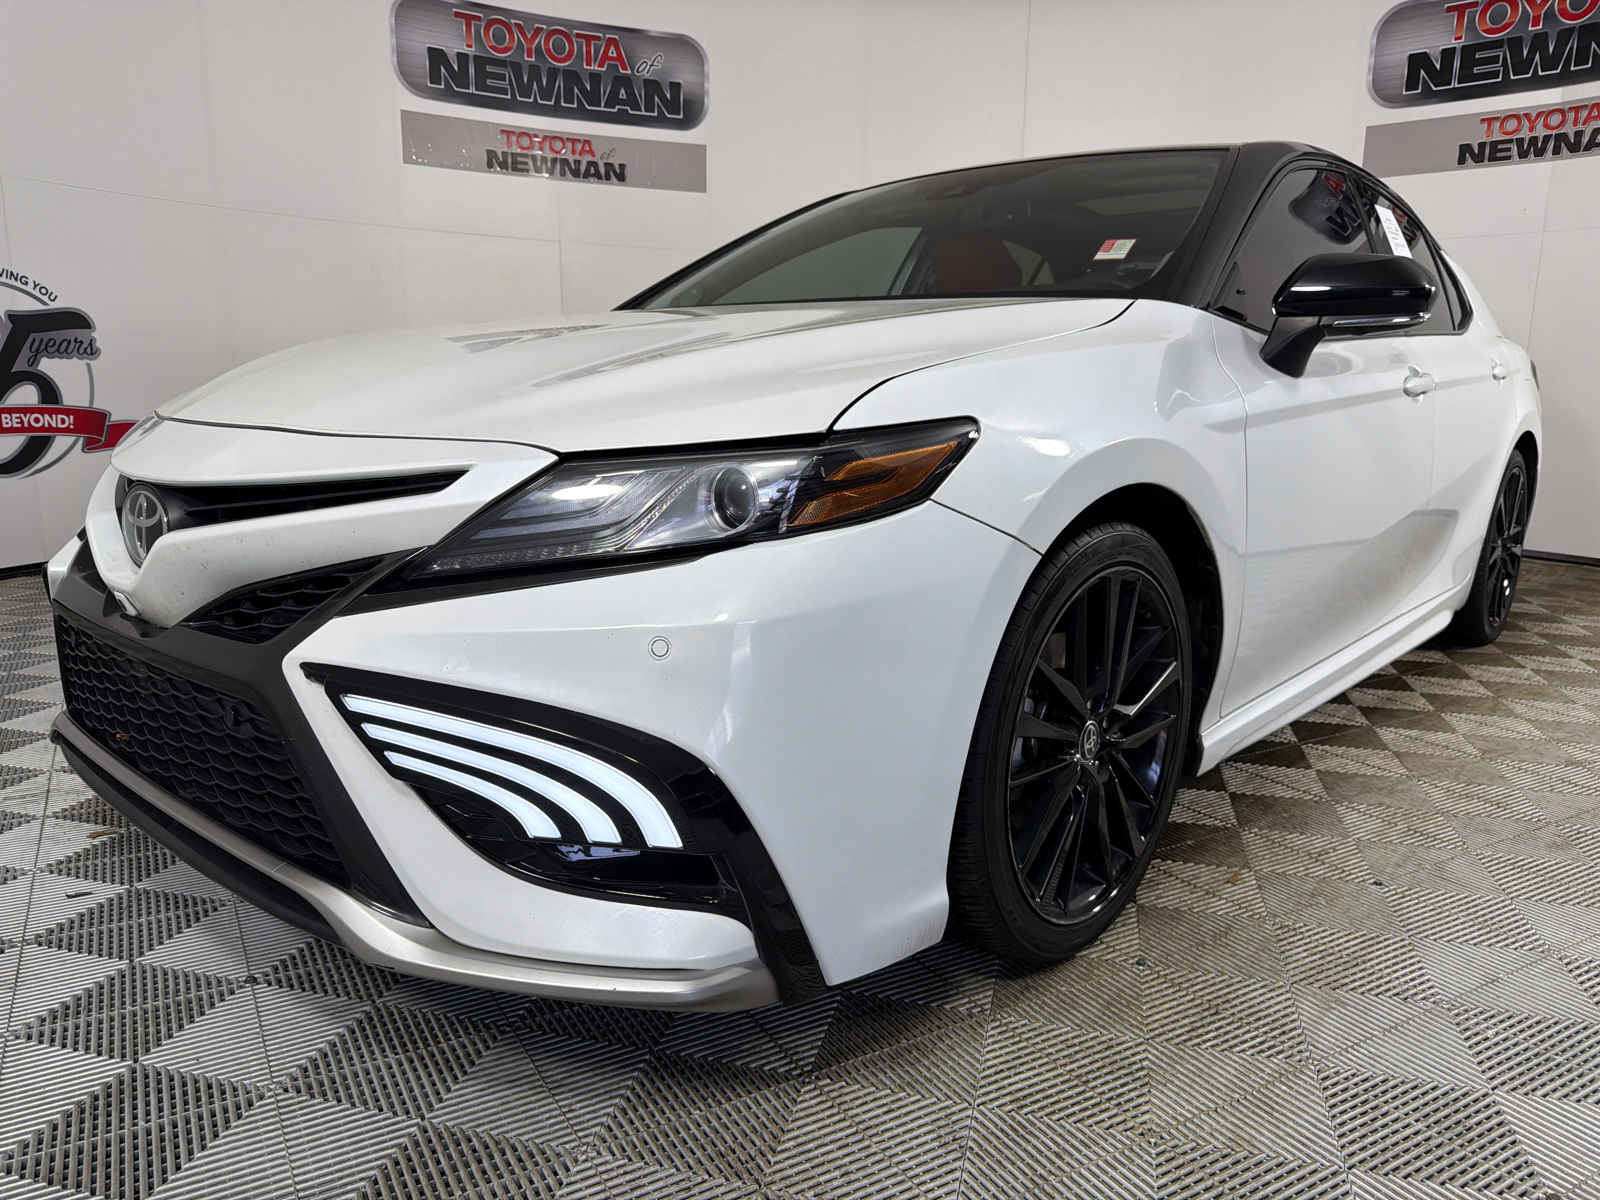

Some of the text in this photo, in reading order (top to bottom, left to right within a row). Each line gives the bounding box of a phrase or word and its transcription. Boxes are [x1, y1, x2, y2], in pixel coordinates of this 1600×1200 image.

[453, 9, 663, 76] TOYOTA of
[426, 45, 684, 119] NEWNAN
[500, 129, 615, 160] TOYOTA of
[485, 148, 627, 183] NEWNAN
[32, 280, 58, 302] YOU
[27, 336, 97, 368] years
[1, 413, 74, 429] BEYOND!
